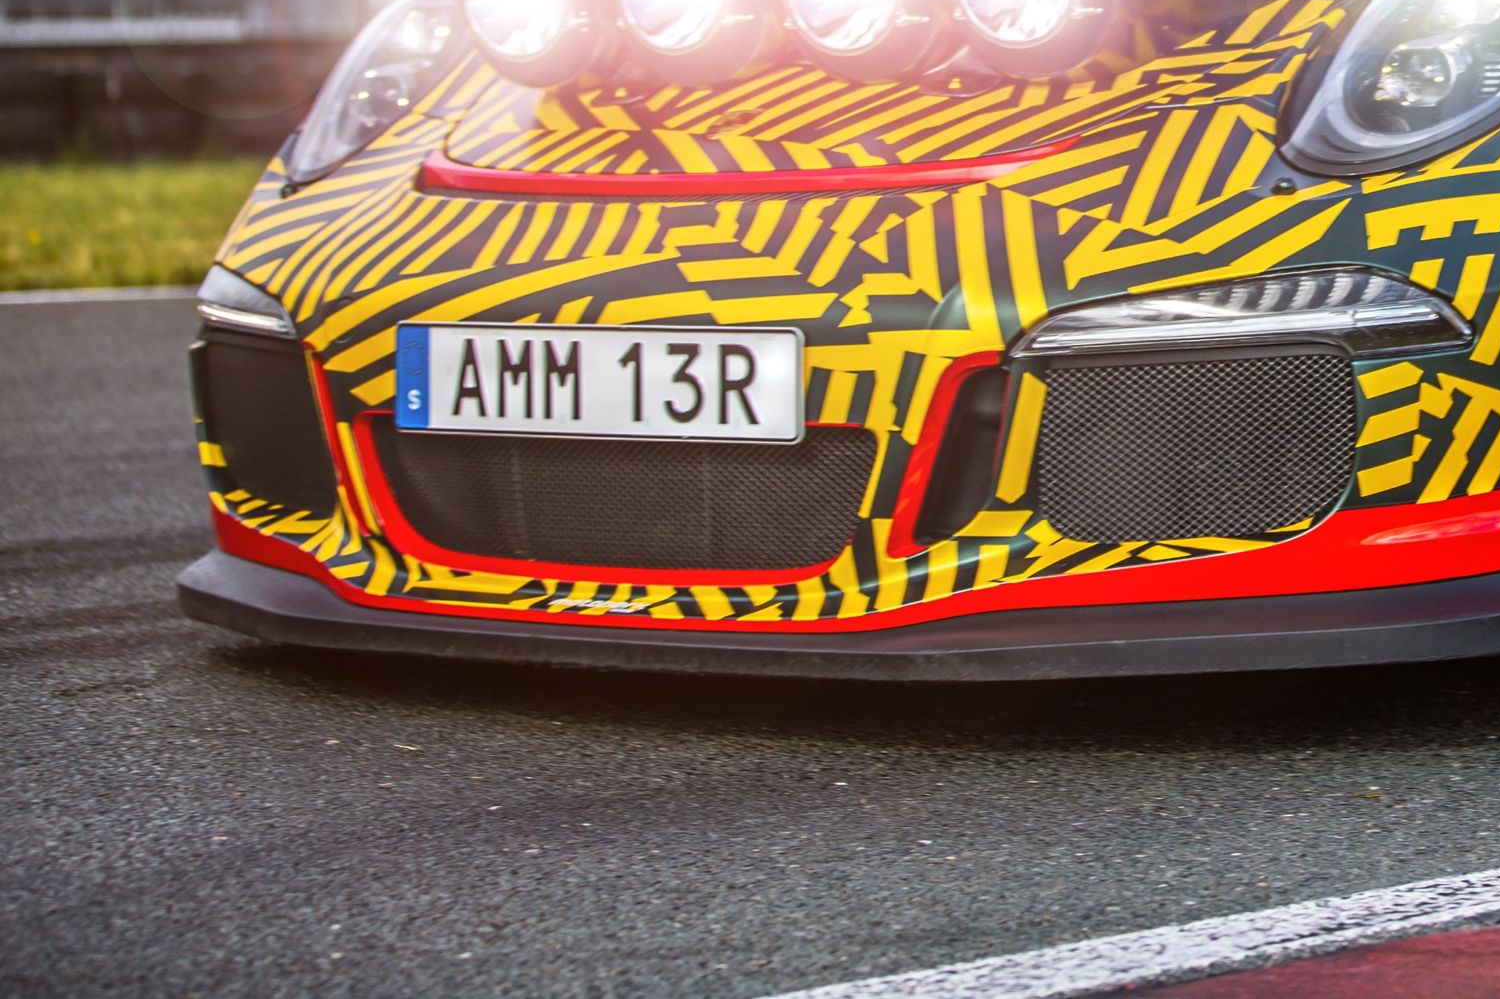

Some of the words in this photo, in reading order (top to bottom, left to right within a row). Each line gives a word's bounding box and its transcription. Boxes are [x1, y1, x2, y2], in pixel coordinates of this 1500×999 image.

[407, 388, 421, 411] S
[452, 337, 582, 420] AMM
[618, 342, 760, 425] 13R
